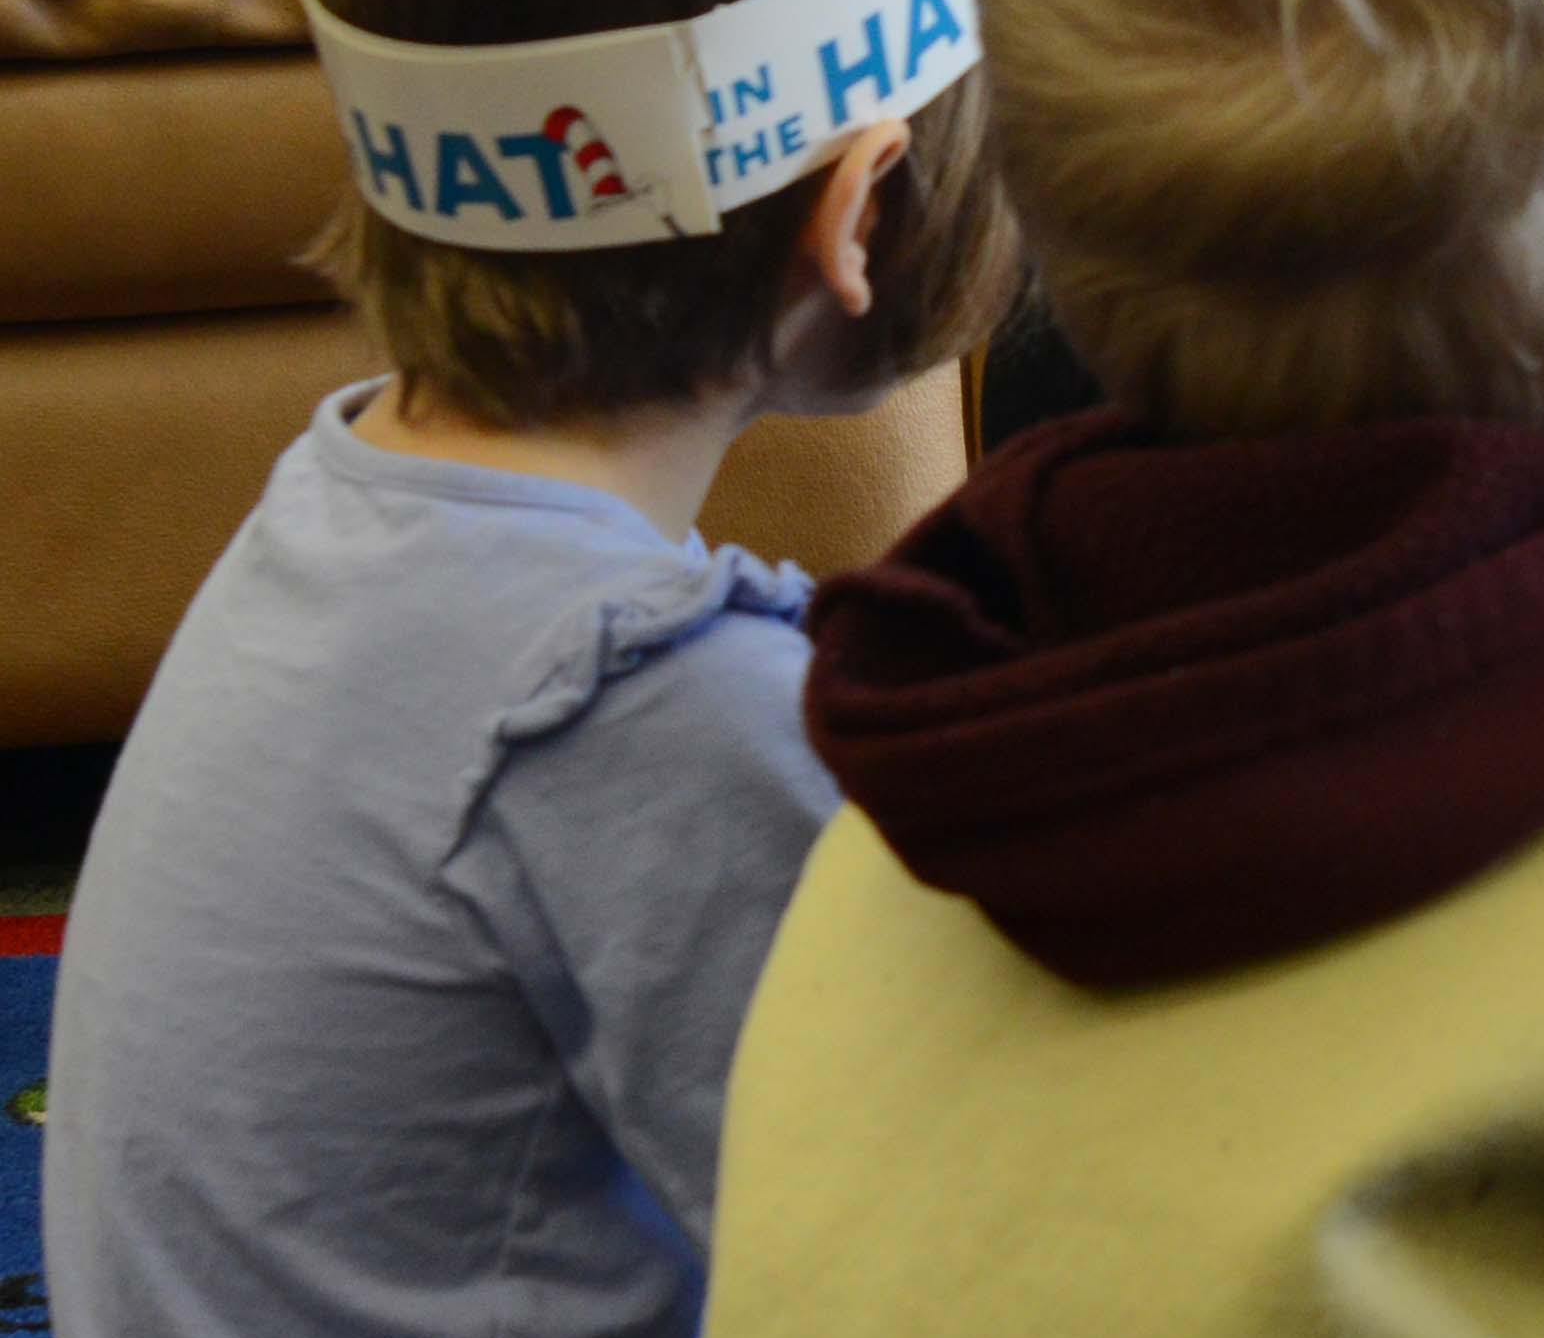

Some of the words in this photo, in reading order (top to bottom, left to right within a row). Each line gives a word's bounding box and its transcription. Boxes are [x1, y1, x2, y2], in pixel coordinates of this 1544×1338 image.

[708, 64, 772, 125] IN
[350, 107, 580, 222] HAT
[705, 112, 808, 185] THE
